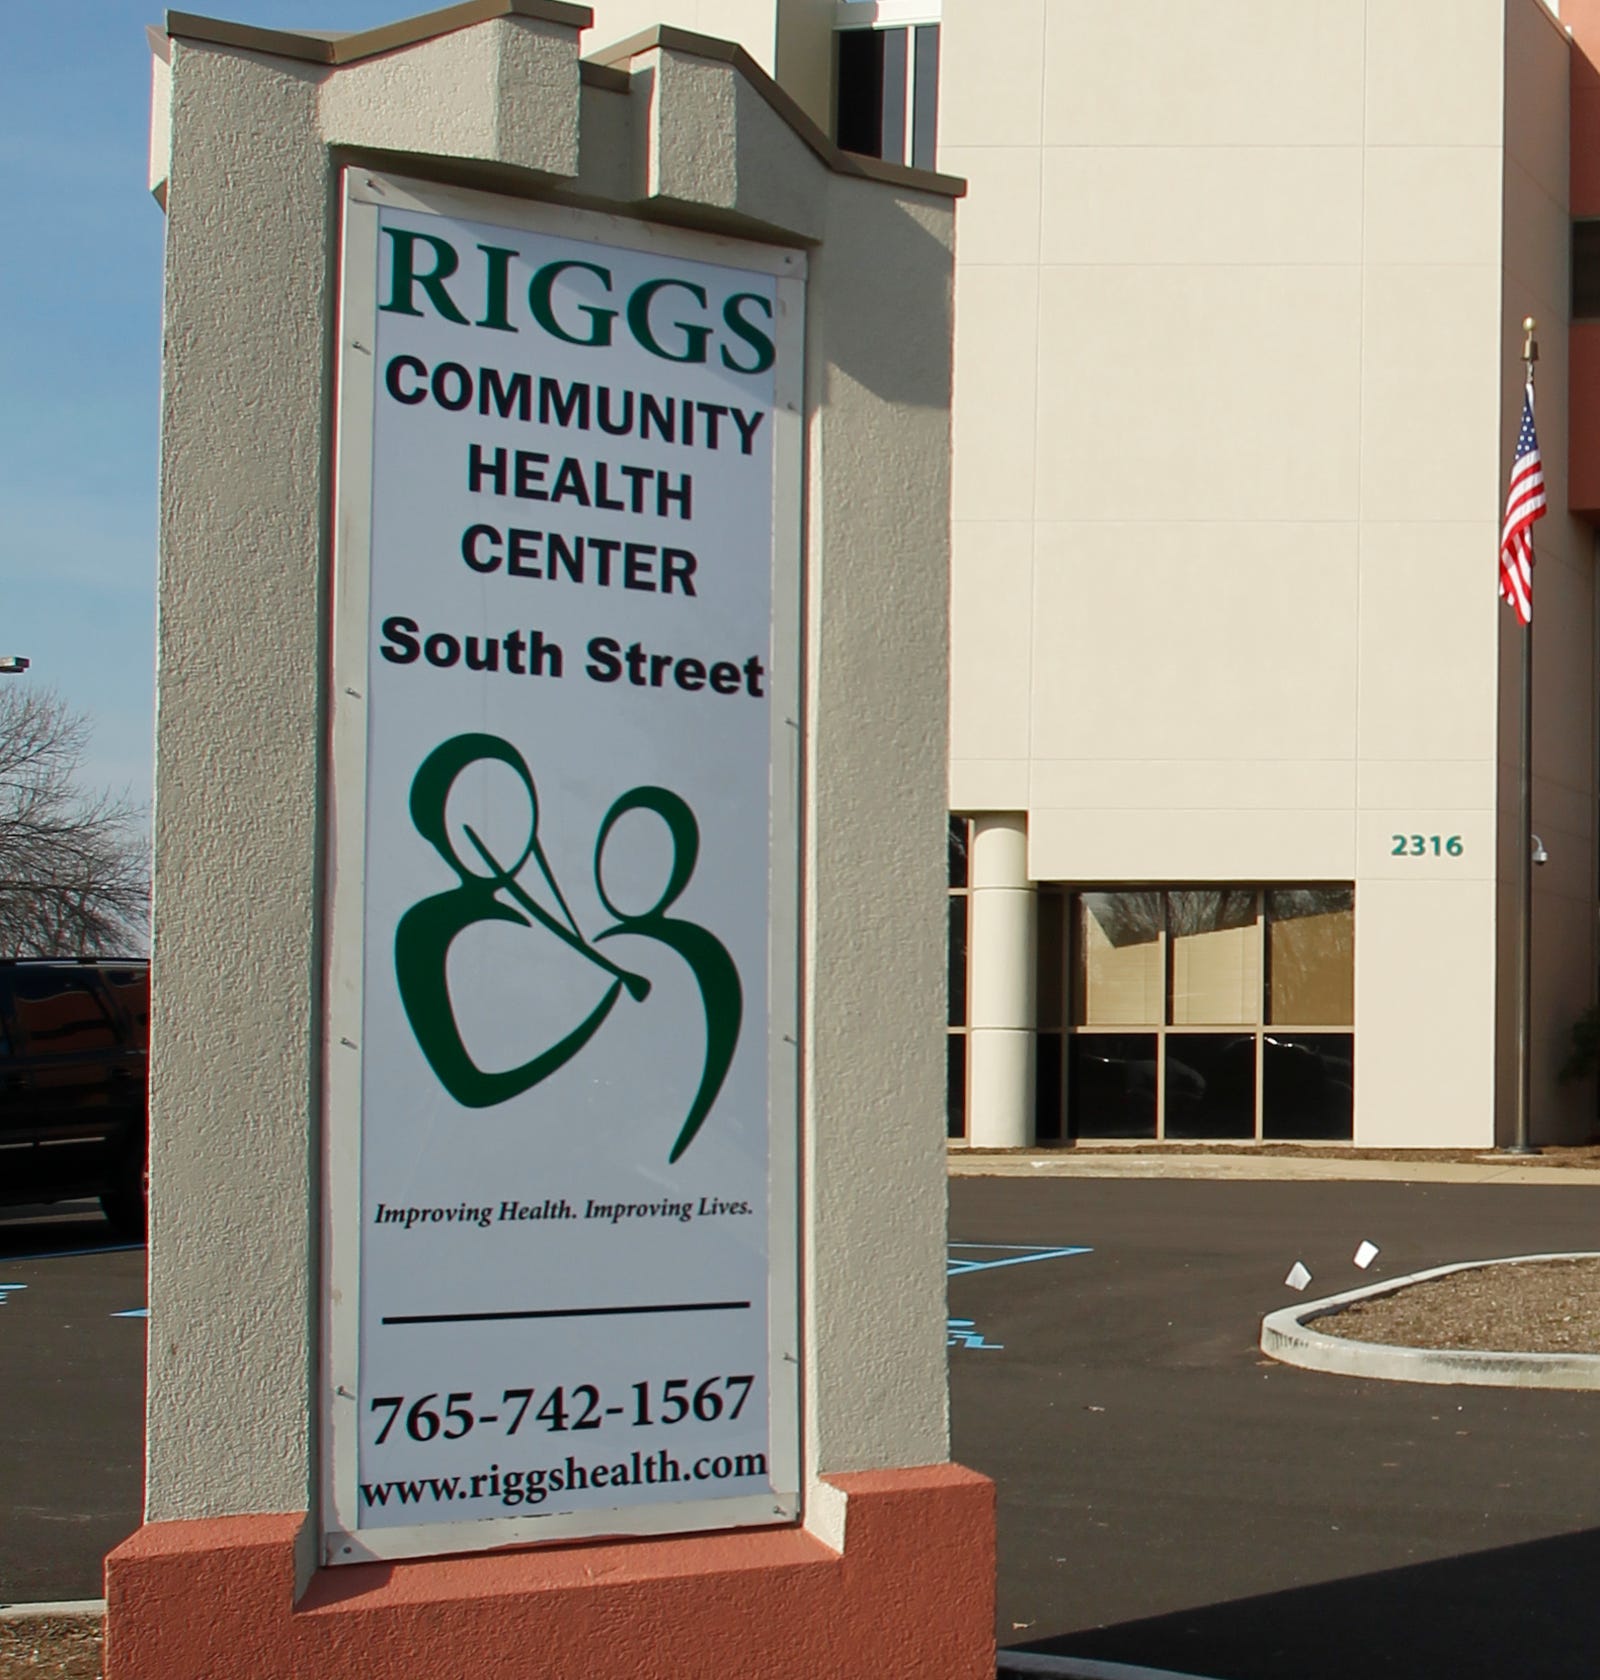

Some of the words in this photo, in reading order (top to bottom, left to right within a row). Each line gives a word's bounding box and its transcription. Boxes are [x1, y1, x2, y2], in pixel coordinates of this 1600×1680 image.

[378, 226, 777, 376] RIGGS
[384, 353, 765, 456] COMMUNITY
[467, 443, 693, 521] HEALTH
[460, 523, 698, 598] CENTER
[379, 615, 564, 679] South
[584, 635, 765, 698] Street
[1390, 833, 1465, 858] 2316
[373, 1202, 494, 1231] Improving
[496, 1199, 578, 1222] Health.
[583, 1197, 694, 1226] Improving
[696, 1196, 755, 1218] Lives.
[369, 1374, 756, 1447] 765-742-1567
[359, 1449, 769, 1508] www.riggshealth.com
